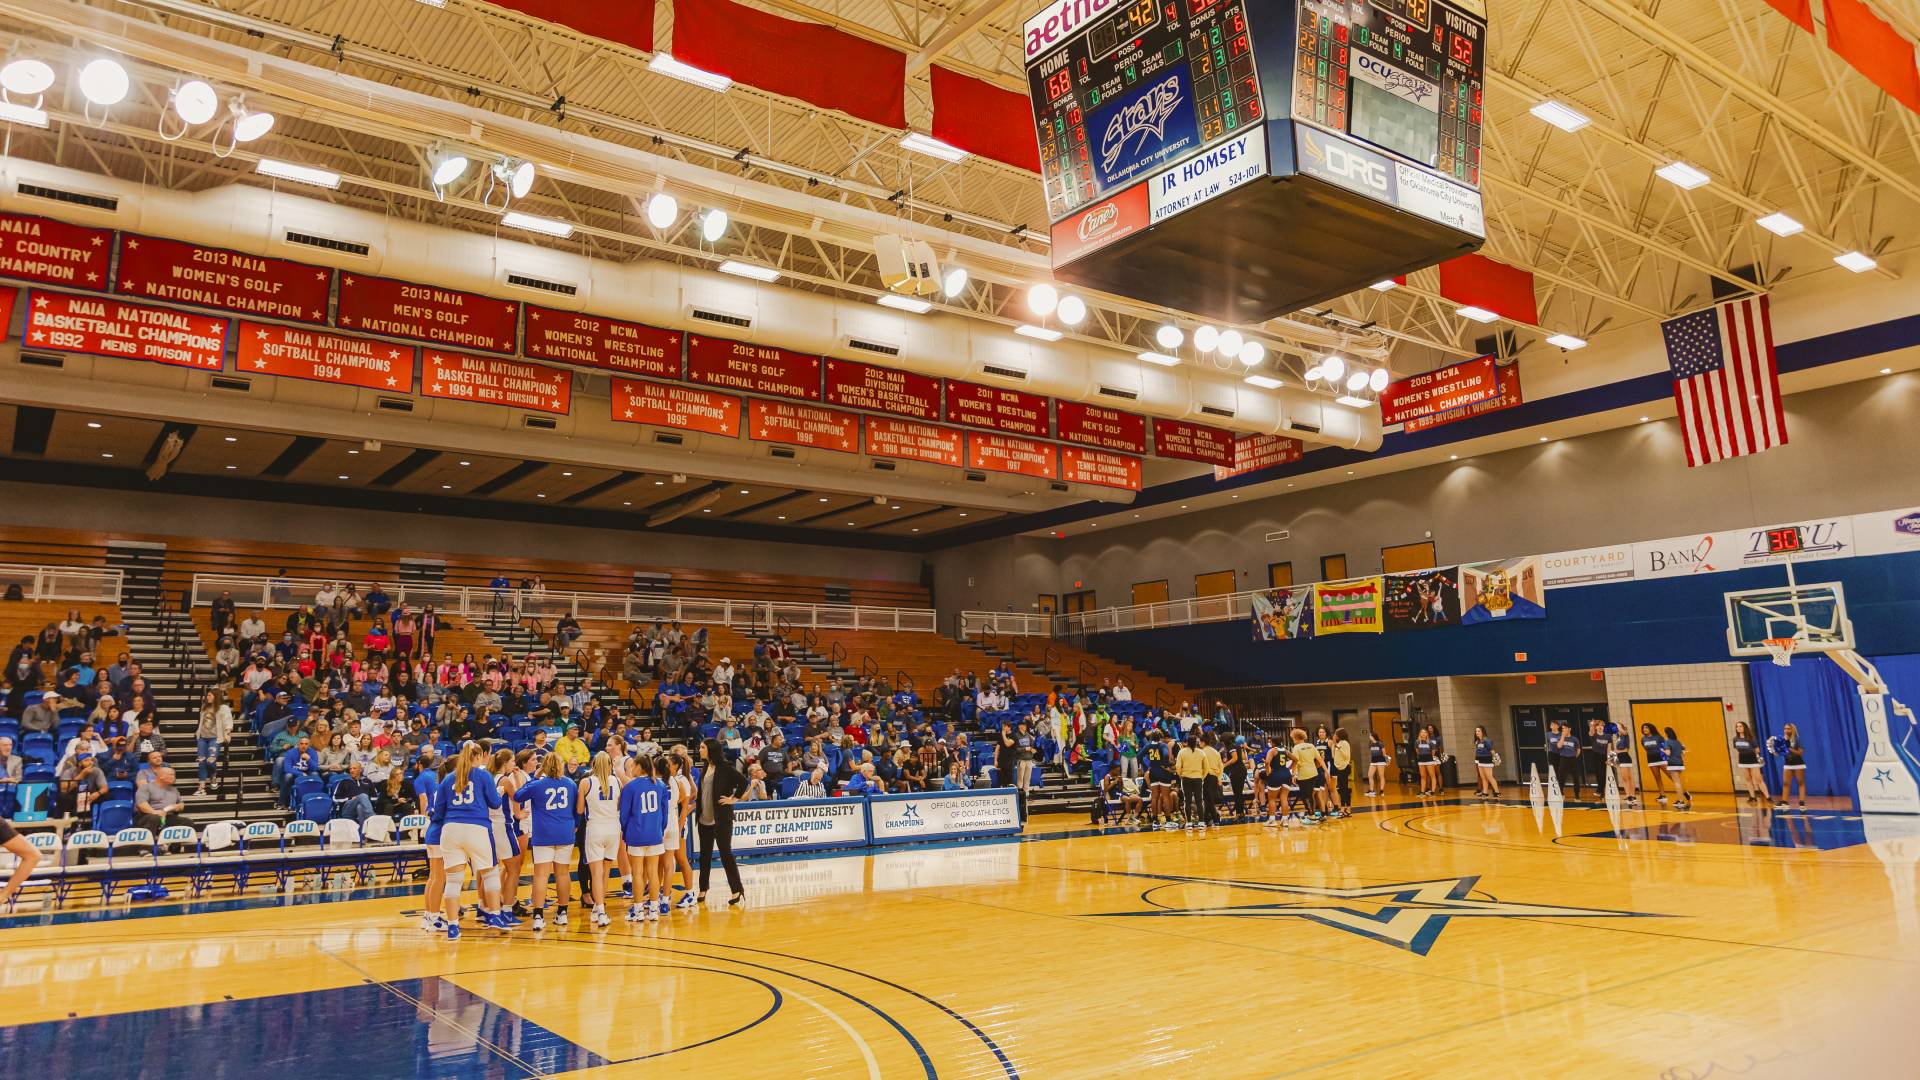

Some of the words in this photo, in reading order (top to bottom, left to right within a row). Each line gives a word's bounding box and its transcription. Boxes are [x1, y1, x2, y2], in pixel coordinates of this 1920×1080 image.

[1190, 8, 1216, 28] BONUS
[1224, 5, 1240, 19] PTS
[1167, 21, 1181, 33] TOL
[1445, 10, 1478, 39] VISITOR
[1233, 35, 1249, 55] 19
[1370, 32, 1389, 46] TEAM
[1385, 26, 1411, 46] PERIOD
[1118, 43, 1136, 58] POSS
[1369, 40, 1389, 55] FOULS
[1407, 49, 1424, 63] TEAM
[1453, 35, 1472, 64] 52
[1040, 49, 1070, 78] HOME
[1114, 49, 1144, 72] PERIOD
[1141, 51, 1162, 68] TEAM
[1141, 59, 1165, 77] FOULS
[1358, 56, 1391, 78] OCU
[1405, 57, 1425, 71] FOULS
[1048, 67, 1072, 99] 68
[1100, 76, 1121, 91] TEAM
[1101, 84, 1123, 100] FOULS
[1053, 93, 1074, 110] BONUS
[1204, 97, 1219, 120] 11
[1204, 118, 1223, 141] 23
[1107, 161, 1140, 183] OKLAHOMA
[1140, 155, 1153, 167] CITY
[1154, 137, 1190, 159] UNIVERSITY
[1161, 172, 1177, 196] JR
[1183, 138, 1247, 182] HOMSEY
[1325, 144, 1387, 191] DRG
[1154, 194, 1191, 219] ATTORNEY
[1193, 189, 1203, 203] AT
[1204, 182, 1220, 197] LAW
[1228, 163, 1260, 187] 524-1011
[1400, 165, 1421, 180] Official
[1422, 172, 1443, 189] Medical
[1444, 182, 1468, 199] Provider
[1440, 191, 1452, 204] City
[1452, 195, 1480, 214] University
[0, 219, 41, 237] NAIA
[1440, 211, 1460, 227] Mercy
[16, 240, 92, 263] COUNTRY
[193, 249, 227, 266] 2013
[231, 256, 267, 273] NAIA
[0, 256, 74, 280] HAMPION
[172, 265, 240, 288] WOMEN'S
[244, 278, 283, 295] GOLF
[146, 282, 222, 305] NATIONAL
[226, 295, 302, 318] CHAMPION
[401, 286, 431, 301] 2013
[434, 292, 463, 306] NAIA
[68, 300, 106, 317] NAIA
[118, 306, 191, 331] NATIONAL
[393, 304, 433, 321] MEN'S
[436, 310, 470, 326] GOLF
[33, 312, 134, 339] BASKETBALL
[138, 326, 221, 352] CHAMPIONS
[361, 318, 426, 338] NATIONAL
[429, 327, 494, 349] CHAMPION
[574, 318, 600, 333] 2012
[610, 324, 639, 340] WCWA
[50, 331, 84, 348] 1992
[100, 338, 138, 355] MENS
[144, 345, 192, 363] DIVISON
[197, 353, 203, 365] I
[284, 330, 312, 348] NAIA
[317, 337, 373, 356] NATIONAL
[544, 329, 593, 347] WOMEN'S
[604, 339, 665, 358] WRESTLING
[732, 344, 756, 357] 2012
[758, 349, 780, 361] NAIA
[263, 342, 321, 363] SOFTBALL
[325, 349, 391, 373] CHAMPIONS
[545, 344, 599, 363] NATIONAL
[609, 354, 665, 373] CHAMPION
[313, 363, 342, 380] 1994
[462, 356, 489, 373] NAIA
[490, 361, 536, 381] NATIONAL
[728, 359, 758, 375] MEN'S
[761, 365, 786, 378] GOLF
[864, 367, 885, 380] 2012
[886, 372, 906, 383] NAIA
[1435, 367, 1460, 381] WCWA
[437, 367, 499, 388] BASKETBALL
[503, 377, 558, 397] CHAMPIONS
[707, 372, 755, 390] NATIONAL
[757, 380, 805, 398] CHAMPION
[864, 377, 899, 391] DIVISION
[1392, 390, 1431, 408] WOMEN'S
[1431, 375, 1482, 397] WRESTLING
[448, 383, 474, 398] 1994
[478, 388, 504, 402] MEN'S
[506, 393, 540, 406] DIVISION
[645, 385, 668, 400] NAIA
[669, 389, 711, 406] NATIONAL
[836, 383, 875, 399] WOMEN'S
[876, 389, 929, 409] BASKETBALL
[977, 387, 994, 400] 2011
[1000, 392, 1020, 404] WCWA
[629, 394, 673, 412] SOFTBALL
[675, 400, 725, 420] CHAMPIONS
[777, 404, 796, 417] NAIA
[797, 407, 833, 424] NATIONAL
[841, 394, 882, 410] NATIONAL
[885, 401, 926, 417] CHAMPION
[958, 398, 992, 412] WOMEN'S
[996, 405, 1037, 421] WRESTLING
[1394, 403, 1435, 421] NATIONAL
[1439, 390, 1485, 410] CHAMPION
[666, 412, 688, 427] 1995
[764, 413, 802, 431] SOFTBALL
[802, 419, 845, 438] CHAMPIONS
[961, 413, 996, 428] NATIONAL
[1000, 419, 1036, 434] CHAMPION
[796, 430, 814, 445] 1996
[1769, 529, 1798, 552] 30
[1544, 551, 1626, 570] COURTYARD
[1279, 754, 1286, 767] 5
[452, 780, 475, 806] 33
[545, 786, 569, 810] 23
[640, 790, 658, 814] 10
[765, 809, 790, 821] CITY
[793, 805, 855, 819] UNIVERSITY
[930, 802, 959, 810] OFFICIAL
[961, 799, 991, 808] BOOSTER
[992, 798, 1008, 806] CLUB
[951, 811, 960, 819] OF
[962, 810, 976, 818] OCU
[977, 808, 1010, 817] ATHLETICS
[249, 823, 276, 835] OCU
[289, 821, 314, 833] OCU
[403, 816, 427, 827] OCU
[733, 825, 757, 836] OME
[760, 824, 772, 835] OF
[775, 820, 833, 834] CHAMPIONS
[885, 819, 924, 829] CHAMPIONS
[73, 833, 101, 845] OCU
[118, 830, 147, 842] OCU
[163, 828, 191, 840] OCU
[756, 835, 809, 846] OCUSPORTS.COM
